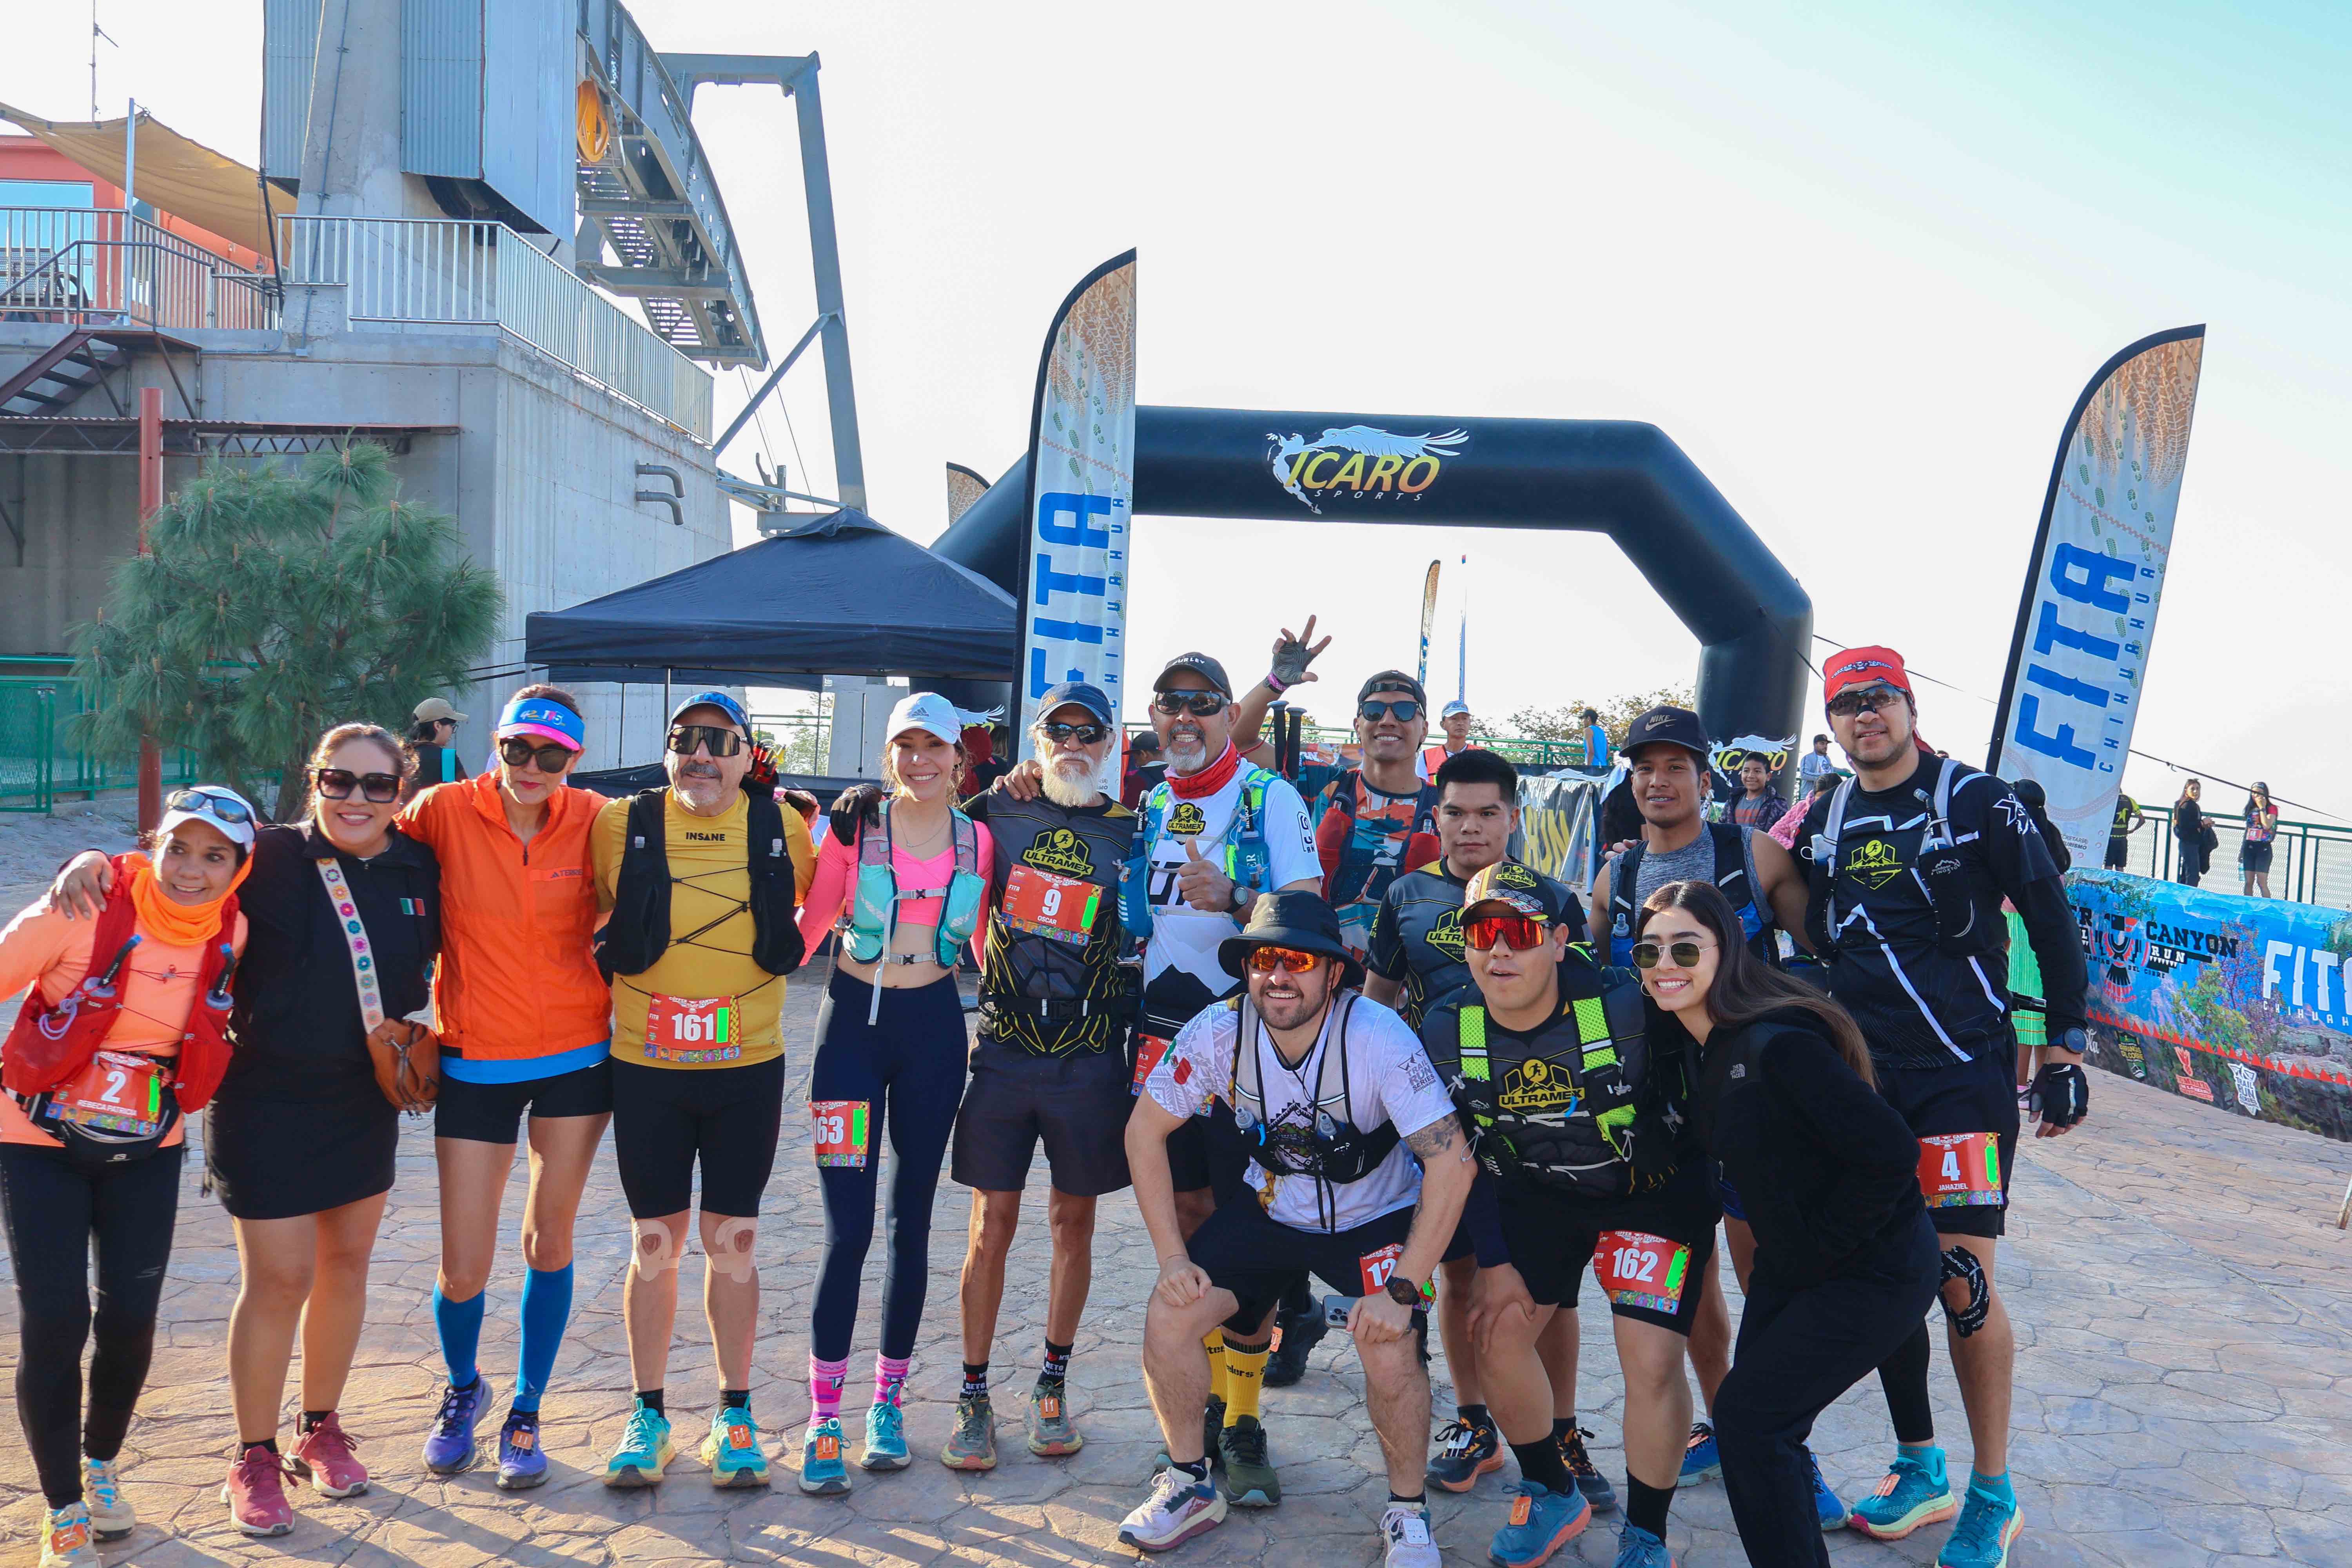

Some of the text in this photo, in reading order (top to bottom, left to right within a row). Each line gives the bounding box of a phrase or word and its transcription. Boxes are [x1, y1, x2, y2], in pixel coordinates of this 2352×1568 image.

[1285, 451, 1440, 493] ICARO
[1314, 489, 1423, 501] SPORTS
[2014, 542, 2137, 771] FITA
[2098, 567, 2156, 773] CHIHUAHUA
[1650, 715, 1671, 723] NIKE
[1715, 750, 1788, 771] ICO
[686, 832, 726, 841] INSANE
[1025, 851, 1090, 874] ULTRAMEX
[1497, 874, 1537, 887] ULTRAMEX
[1042, 889, 1062, 916] 9
[1037, 915, 1057, 925] OSCAR
[2146, 921, 2239, 958] CANYON
[2151, 945, 2186, 962] RUN
[2128, 965, 2140, 973] DEL
[2144, 969, 2165, 979] COBRE
[671, 1013, 714, 1041] 161
[1406, 1059, 1428, 1077] TRAIL
[1408, 1065, 1432, 1086] RUN
[100, 1071, 126, 1104] 2
[1412, 1074, 1435, 1091] SERIES
[1501, 1088, 1583, 1105] ULTRAMEX
[1941, 1151, 1960, 1181] 4
[1612, 1247, 1658, 1283] 162
[1942, 1251, 1968, 1272] COMPEX
